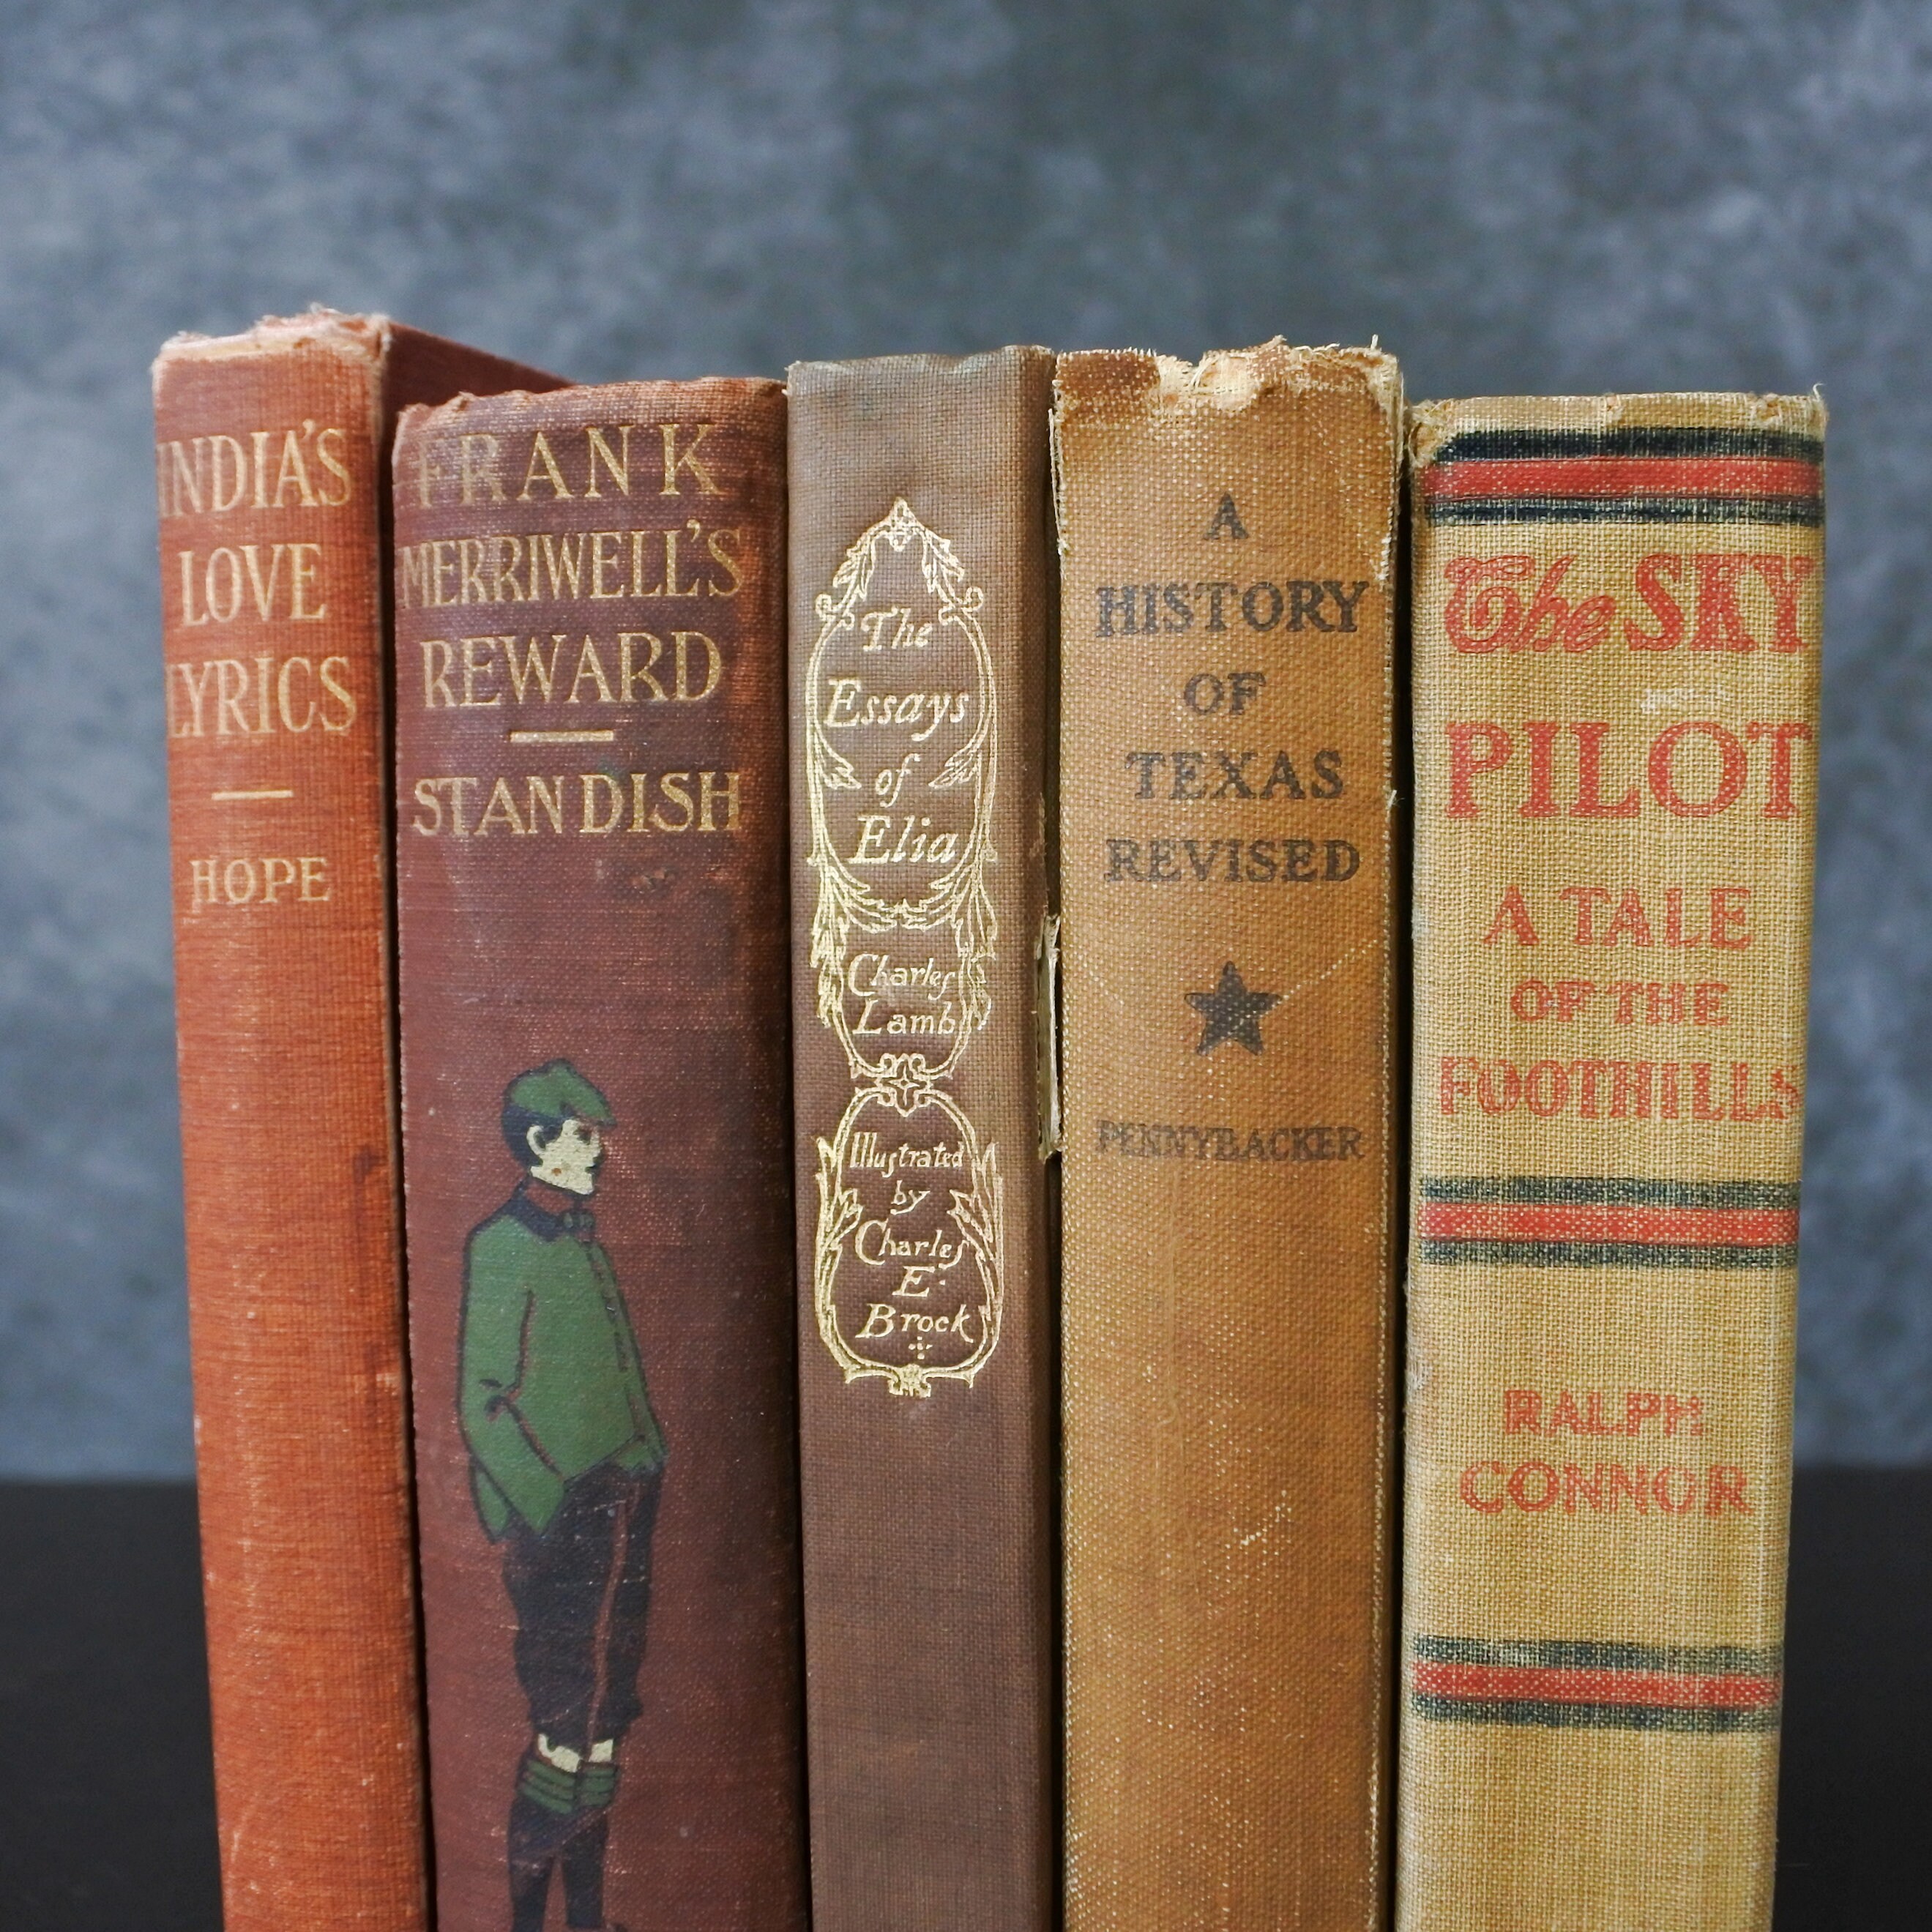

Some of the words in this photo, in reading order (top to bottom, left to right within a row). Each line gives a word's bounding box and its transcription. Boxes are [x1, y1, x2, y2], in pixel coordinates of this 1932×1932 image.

[416, 423, 722, 508] FRANK
[1204, 492, 1249, 540] A
[178, 544, 327, 627] LOVE
[400, 519, 744, 609] MERRIWELL'S
[861, 605, 933, 652] The
[1096, 581, 1369, 638] HISTORY
[1444, 554, 1616, 654] The
[1624, 552, 1816, 654] SKY
[420, 630, 724, 708] REWARD
[1183, 672, 1266, 716] OF
[166, 656, 359, 739] LYRICS
[824, 678, 969, 742] Essays
[875, 753, 921, 808] of
[1126, 750, 1344, 799] TEXAS
[1445, 721, 1813, 819] PILOT
[412, 771, 742, 838] STANDISH
[847, 814, 958, 864] Elia
[1103, 838, 1360, 883] REVISED
[190, 857, 332, 906] HOPE
[1483, 884, 1539, 946] A
[1559, 887, 1753, 949] TALE
[847, 952, 957, 1001] Charles
[851, 999, 956, 1036] Lamb
[1510, 979, 1596, 1023] OF
[1608, 982, 1730, 1026] THE
[1440, 1056, 1804, 1122] FOOTHILLS
[848, 1131, 964, 1178] Illustrated
[891, 1180, 930, 1215] by
[854, 1219, 969, 1270] Charles
[855, 1302, 974, 1343] Brock
[1504, 1390, 1704, 1438] RALPH
[1461, 1460, 1754, 1518] CONNOR
